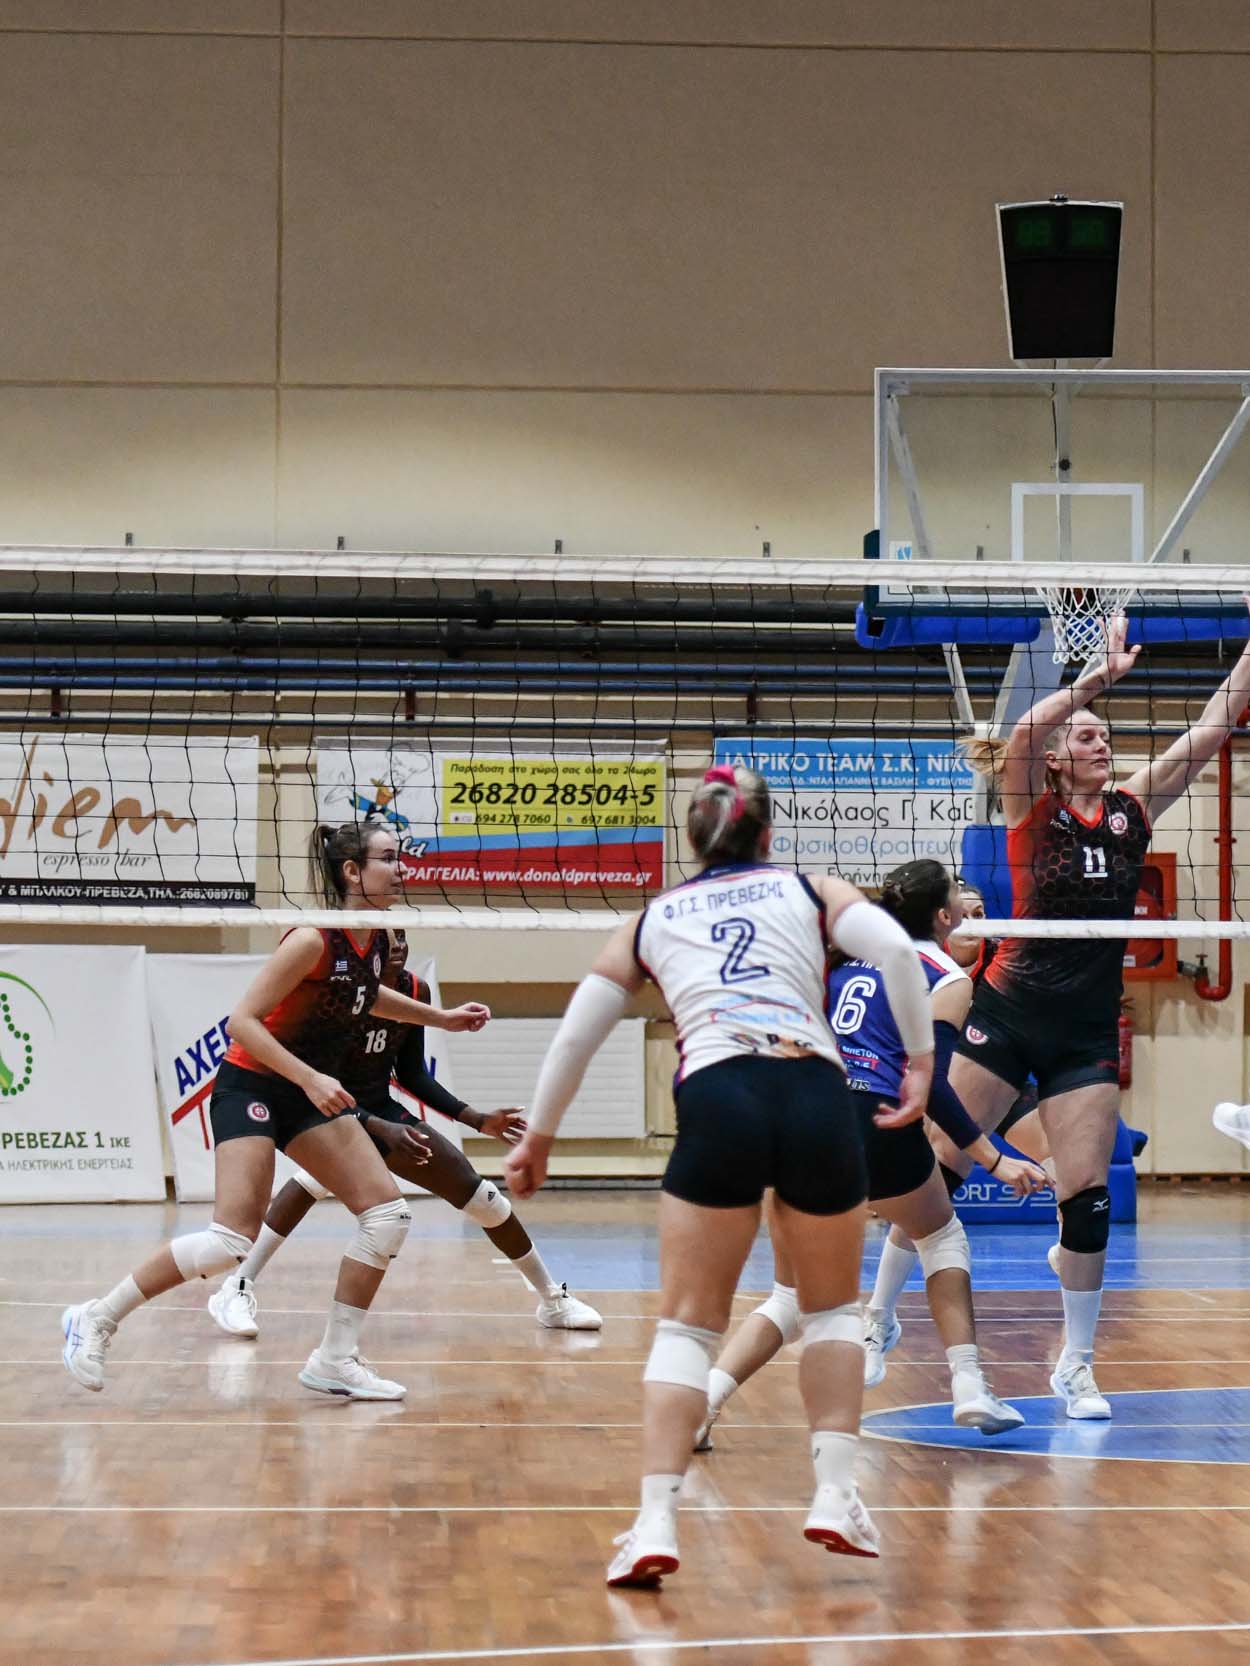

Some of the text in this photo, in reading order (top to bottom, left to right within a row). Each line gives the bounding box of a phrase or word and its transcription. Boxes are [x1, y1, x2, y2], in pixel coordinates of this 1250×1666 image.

[450, 782, 657, 806] 26820 28504-5
[524, 814, 551, 824] 7060
[604, 816, 625, 825] 681
[772, 799, 890, 827] Νικόλαος
[43, 848, 152, 873] espresso bar
[403, 867, 653, 886] ΡΑΓΓΕΛΙΑ: www.donaldpreveza.gr
[708, 881, 786, 912] ΠΡΕΒΕΖΗΣ
[711, 917, 770, 985] 2
[352, 985, 366, 1015] 5
[831, 975, 877, 1036] 6
[365, 1028, 388, 1054] 18
[94, 1131, 105, 1148] 1
[110, 1136, 131, 1148] ΙΚΕ
